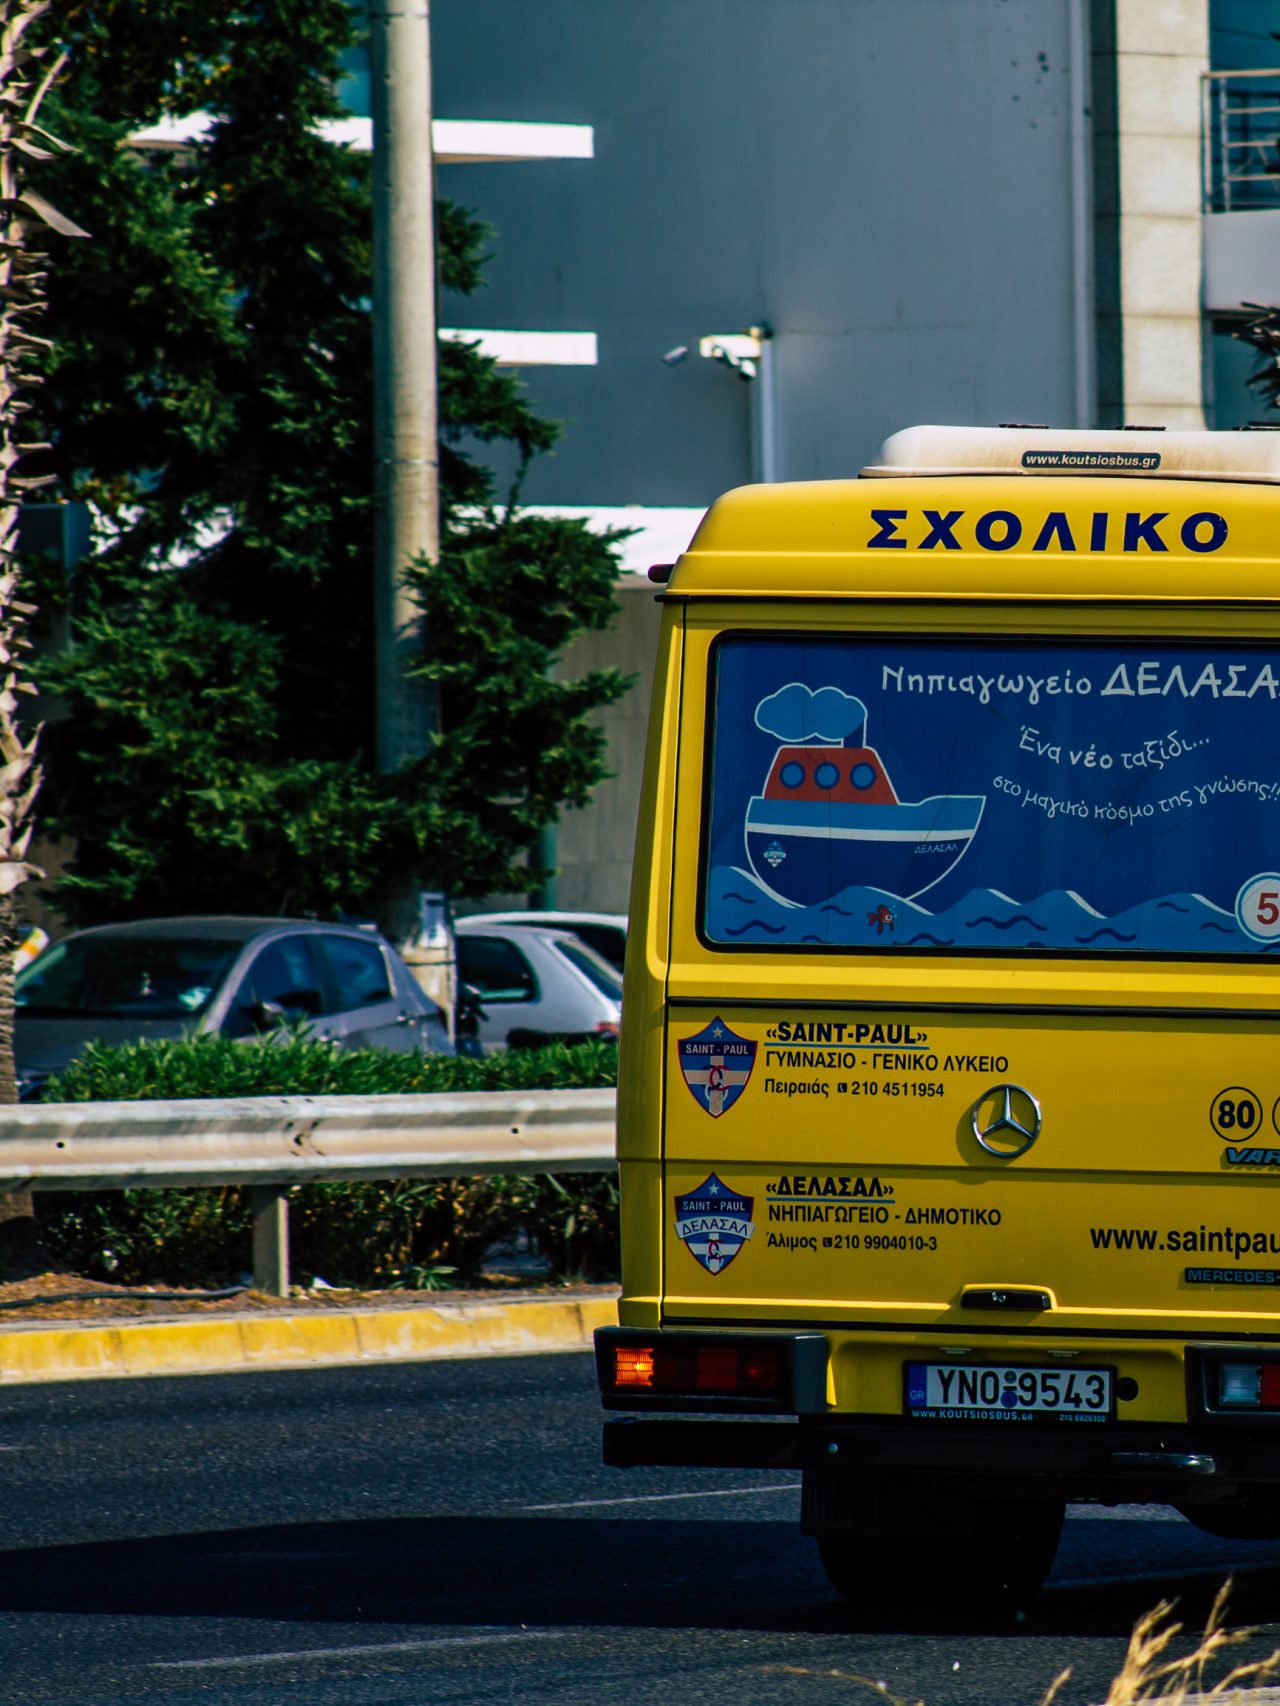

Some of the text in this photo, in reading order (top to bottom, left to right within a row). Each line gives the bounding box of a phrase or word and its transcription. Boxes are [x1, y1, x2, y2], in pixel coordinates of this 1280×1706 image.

[1026, 453, 1158, 470] www.koutsiosbus.gr
[866, 509, 1229, 552] ΣΧΟΛΙΚΟ
[881, 664, 1092, 705] Νηπιαγωγείο
[1018, 725, 1061, 764] Ένα
[1069, 743, 1113, 769] νέο
[992, 775, 1021, 796] στο
[1021, 789, 1089, 818] μαγικό
[1094, 799, 1154, 826] κόσμο
[1158, 790, 1193, 813] της
[1255, 892, 1280, 925] 5
[765, 1020, 929, 1045] «SAINT-PAUL»
[685, 1044, 715, 1056] SAINT
[723, 1045, 750, 1056] PAUL
[765, 1051, 857, 1070] ΓΥΜΝΑΣΙΟ
[872, 1053, 939, 1071] ΓΕΝΙΚΟ
[943, 1055, 1009, 1073] ΛΥΚΕΙΟ
[764, 1077, 944, 1098] Πειραιάς 210 4511954
[1217, 1099, 1256, 1130] 80
[765, 1175, 895, 1198] «ΔΕΛΑΣΑΛ»
[682, 1200, 711, 1211] SAINT
[720, 1201, 746, 1211] PAUL
[767, 1204, 890, 1224] ΝΗΠΙΑΓΩΓΕΙΟ
[904, 1206, 1002, 1226] ΔΗΜΟΤΙΚΟ
[681, 1217, 749, 1237] ΔΕΛΑΣΑΛ
[765, 1231, 938, 1252] Άλιμος 210 9904010-3
[909, 1390, 925, 1400] GR
